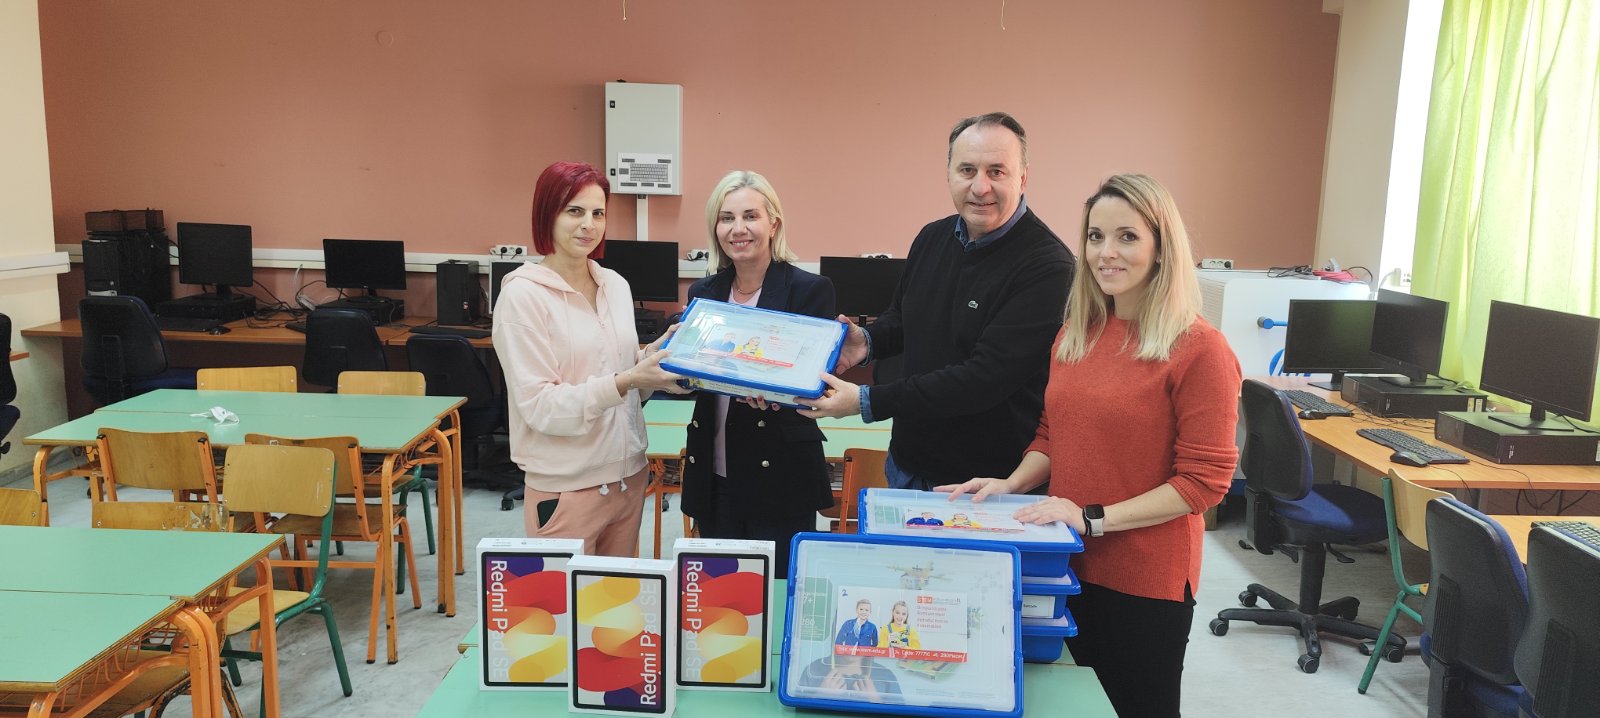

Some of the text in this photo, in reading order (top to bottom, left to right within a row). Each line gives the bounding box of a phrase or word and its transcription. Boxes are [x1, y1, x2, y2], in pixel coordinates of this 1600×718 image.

[491, 560, 508, 612] Redmi
[685, 561, 703, 612] Redmi
[491, 618, 508, 653] Pad
[640, 583, 657, 705] Redmi Pad SE
[686, 618, 702, 651] Pad
[492, 656, 508, 679] SE
[686, 656, 701, 678] SE
